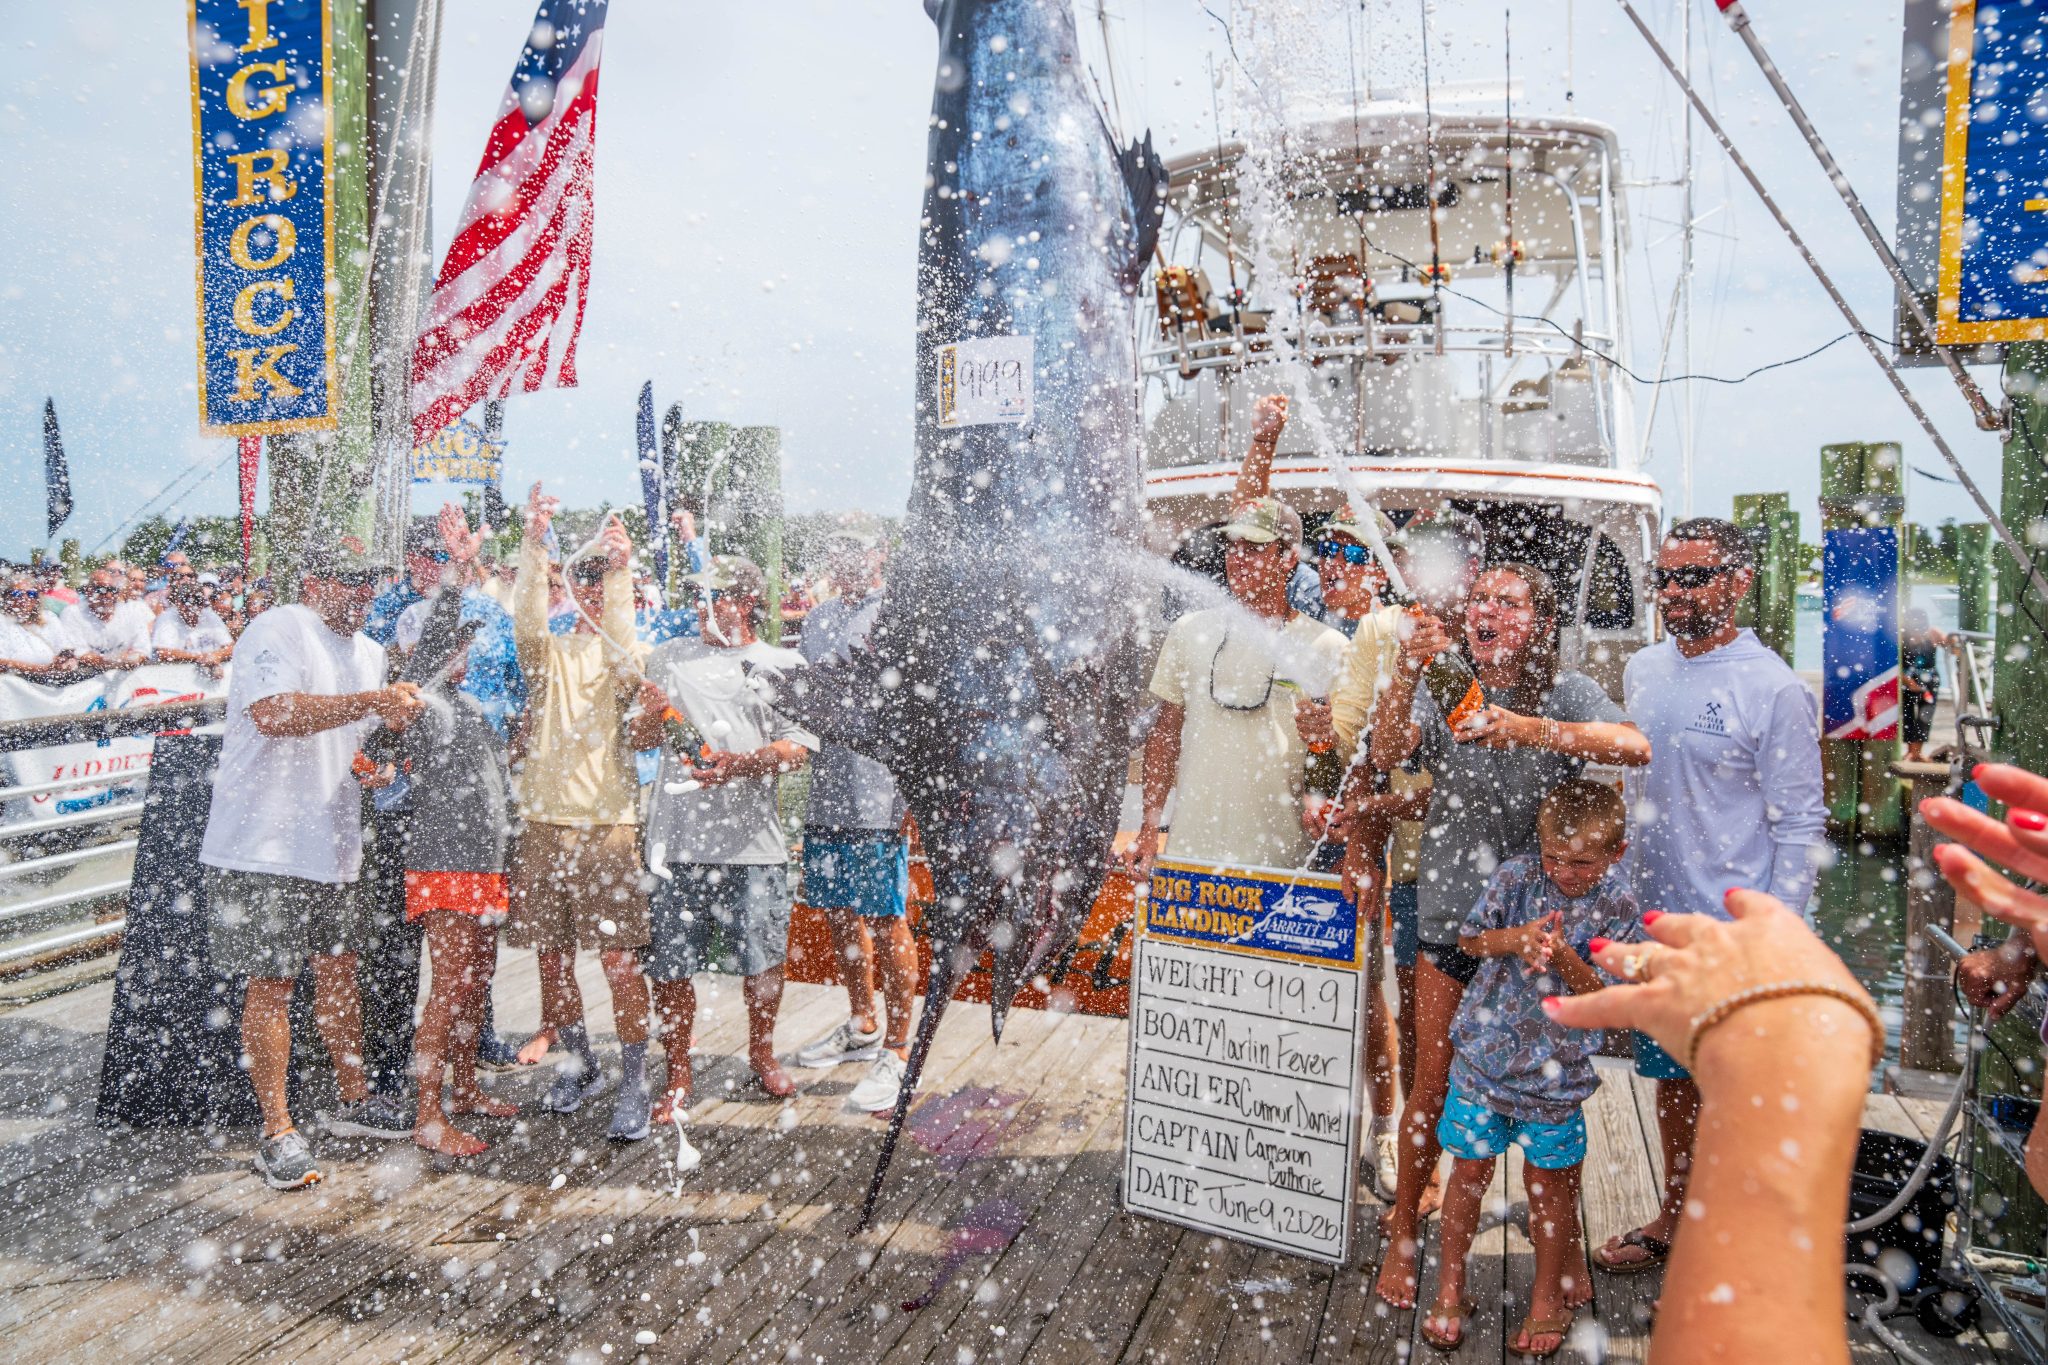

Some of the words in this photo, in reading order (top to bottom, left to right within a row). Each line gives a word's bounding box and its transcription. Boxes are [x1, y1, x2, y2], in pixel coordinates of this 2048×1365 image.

[226, 148, 303, 402] ROCK
[1151, 875, 1192, 902] BIG
[1198, 881, 1264, 912] ROCK
[1150, 902, 1254, 940] LANDING
[1259, 917, 1323, 938] JARRETT
[1321, 926, 1353, 944] BAY
[1147, 955, 1244, 997] WEIGHT
[1254, 969, 1339, 1022] 919.9
[1144, 1008, 1209, 1046] BOAT
[1206, 1018, 1271, 1069] Marlin
[1277, 1031, 1338, 1077] Fever
[1141, 1063, 1240, 1108] ANGLER
[1296, 1091, 1342, 1141] Daniel
[1138, 1114, 1240, 1162] CAPTAIN
[1246, 1127, 1312, 1167] Cameron
[1136, 1165, 1199, 1206] DATE
[1267, 1160, 1325, 1196] Guthrie
